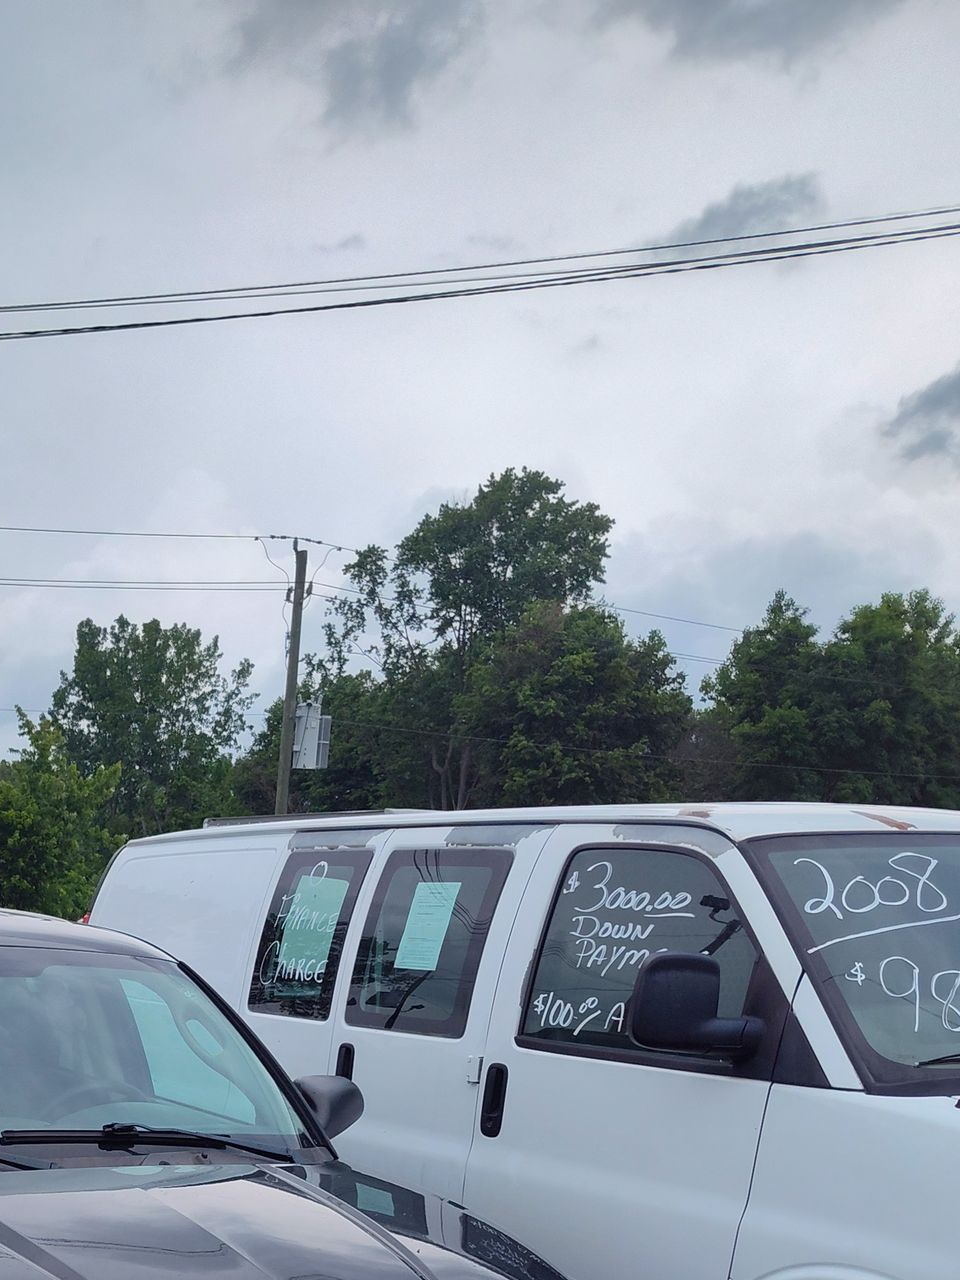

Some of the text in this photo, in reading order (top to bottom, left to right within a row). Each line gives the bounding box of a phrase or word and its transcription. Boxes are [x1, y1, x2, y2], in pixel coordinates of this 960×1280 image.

[563, 861, 692, 912] $3000.00
[794, 852, 948, 920] 2008
[273, 892, 339, 933] FINANCE
[569, 915, 655, 941] DOWN
[259, 940, 329, 985] CHARGE
[575, 938, 668, 977] PAYM
